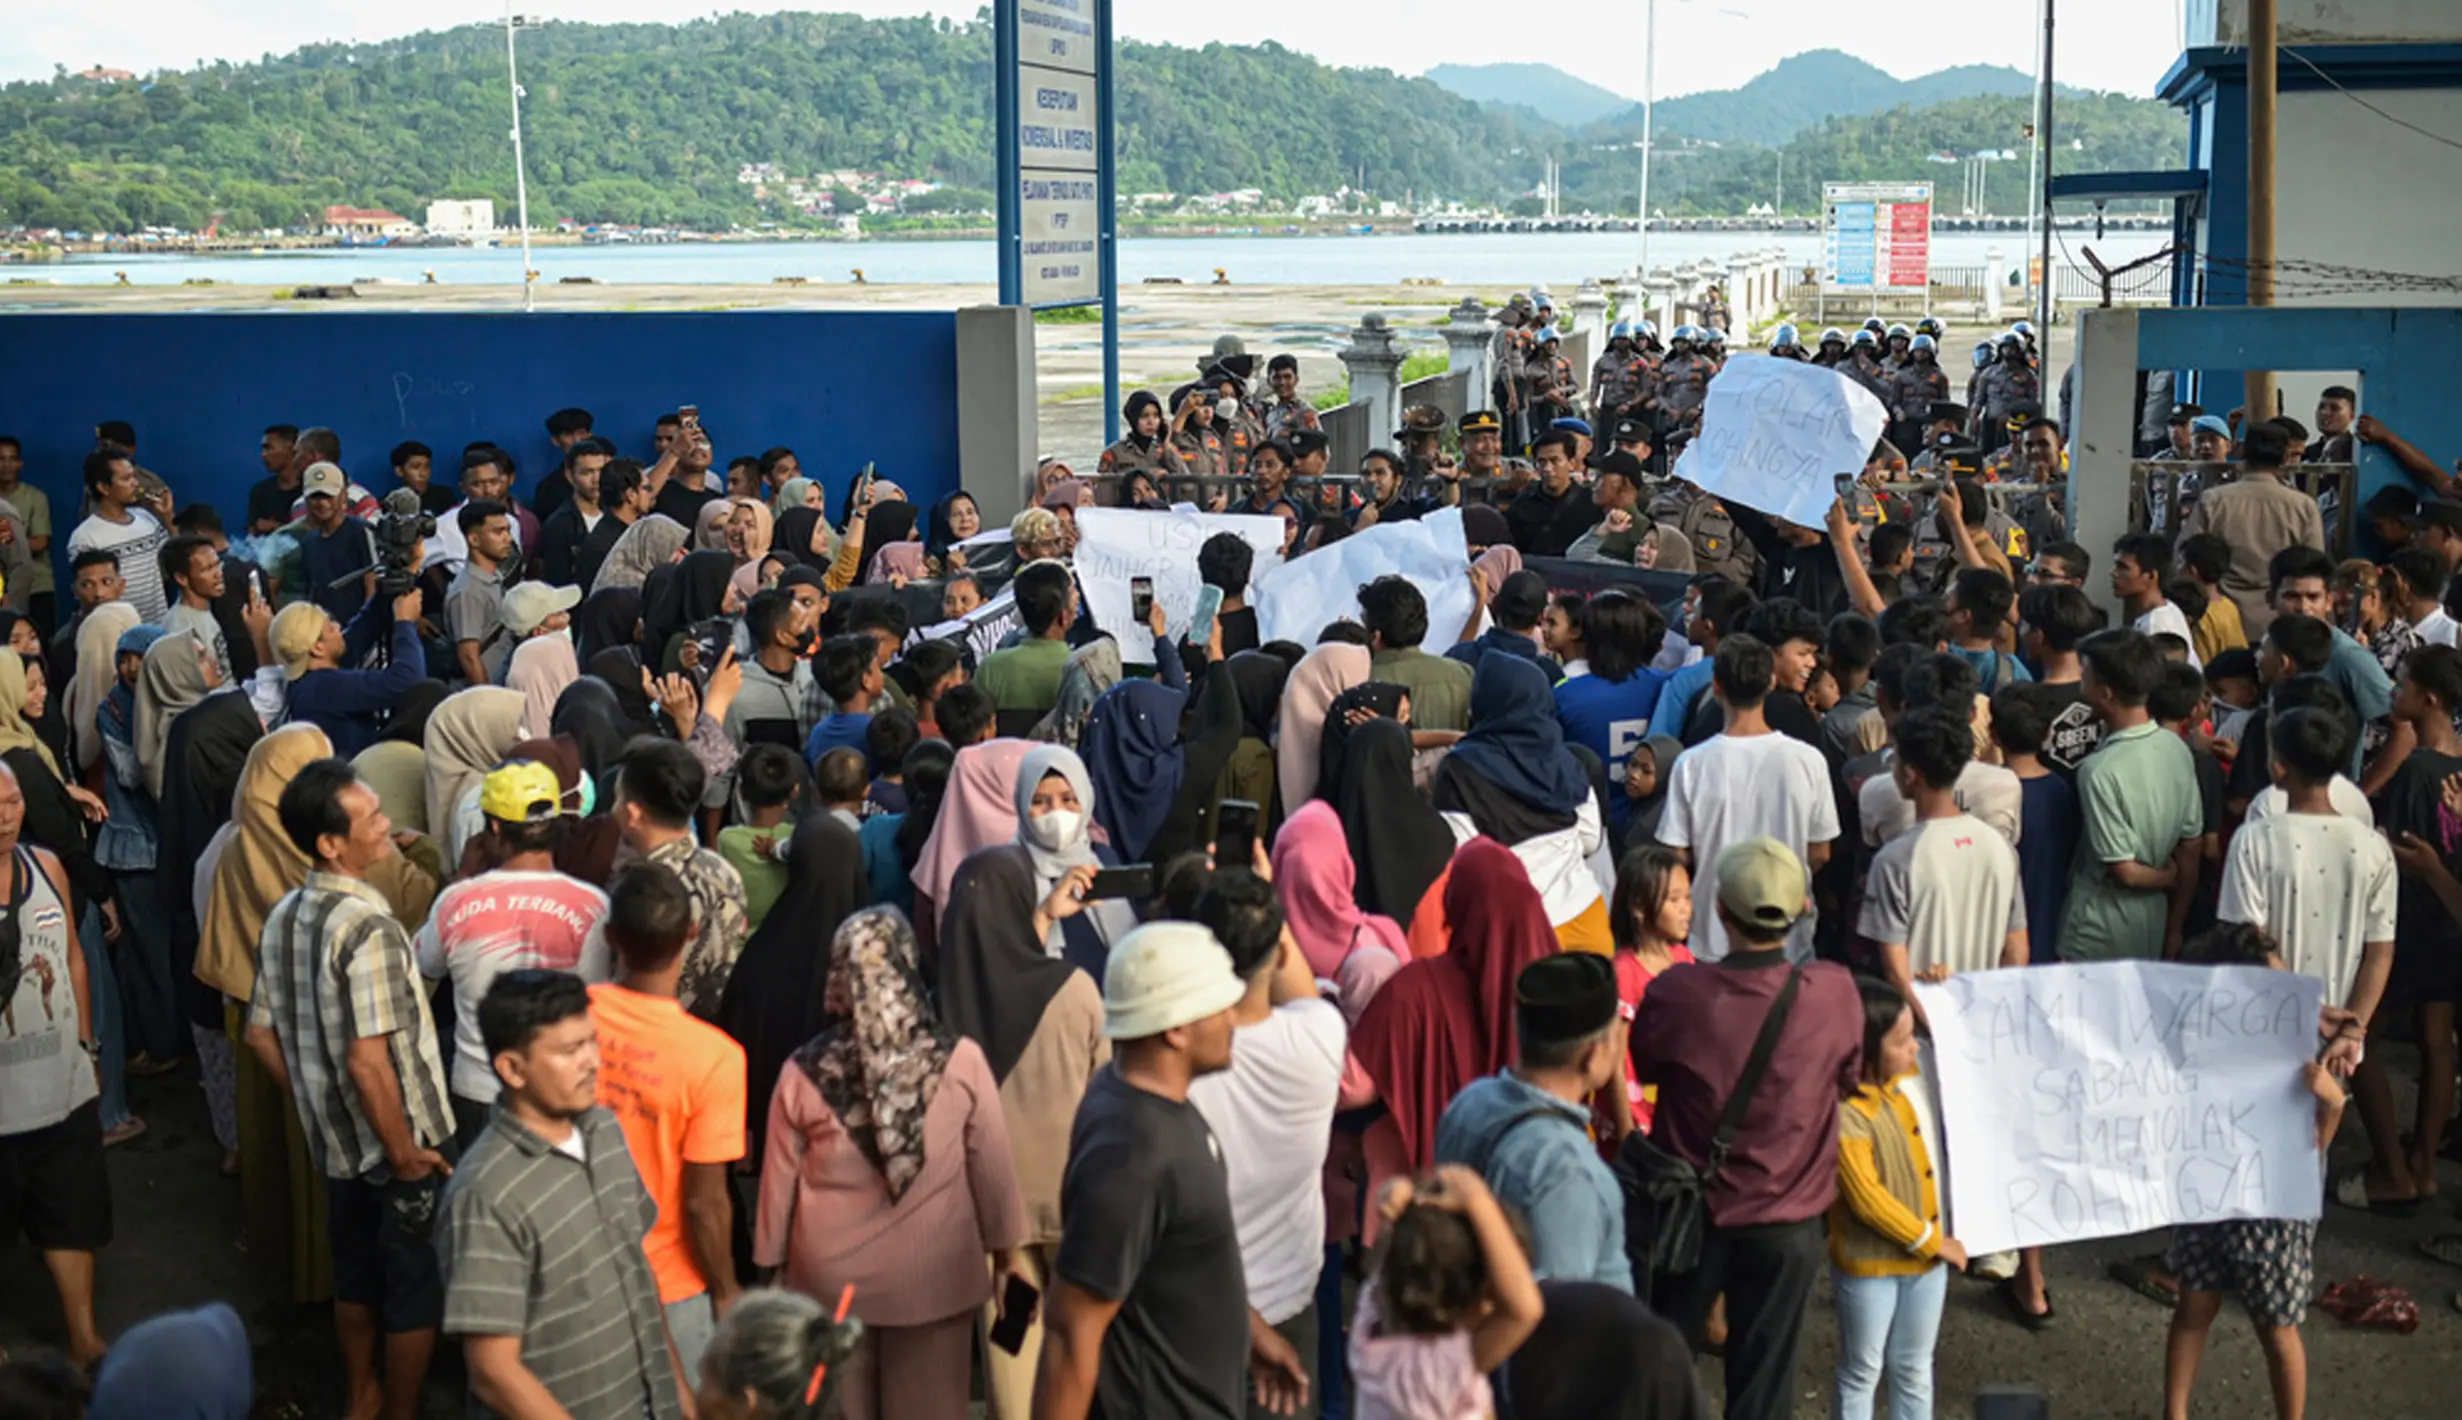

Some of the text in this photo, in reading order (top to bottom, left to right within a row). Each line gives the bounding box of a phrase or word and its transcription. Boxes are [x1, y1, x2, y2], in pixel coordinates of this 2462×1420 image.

[2034, 1057, 2200, 1117] SABANG
[2075, 1101, 2262, 1164] MENOLAK
[2006, 1149, 2268, 1245] ROHINGYA
